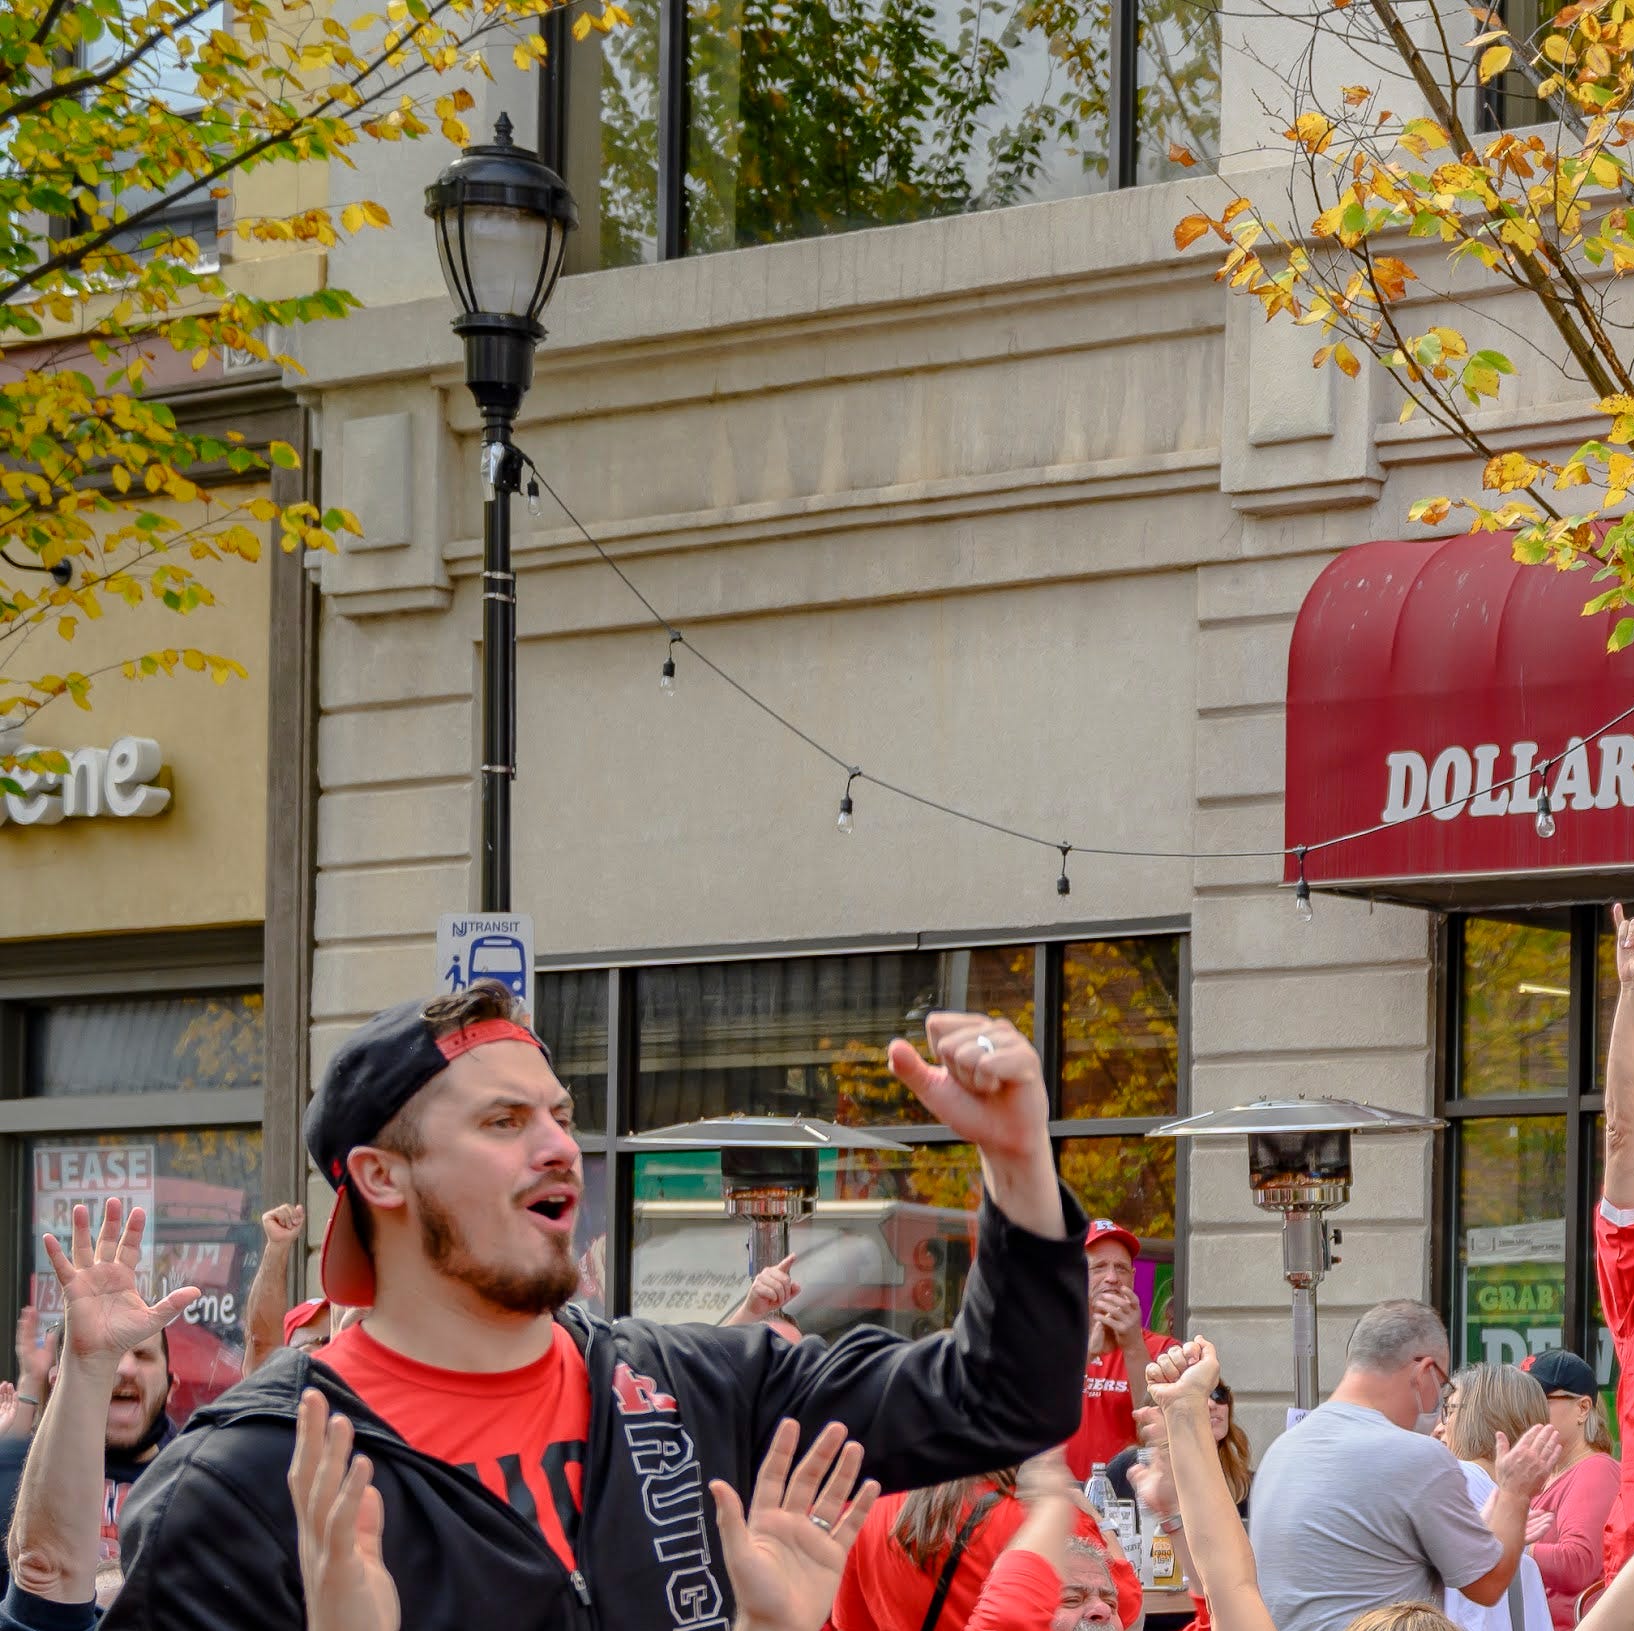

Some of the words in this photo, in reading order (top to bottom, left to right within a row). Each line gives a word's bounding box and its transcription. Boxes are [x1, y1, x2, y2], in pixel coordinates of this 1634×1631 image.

[468, 922, 520, 932] TRANSIT
[40, 1151, 148, 1189] LEASE
[1478, 1285, 1554, 1312] GRAB
[1083, 1376, 1129, 1393] GERS
